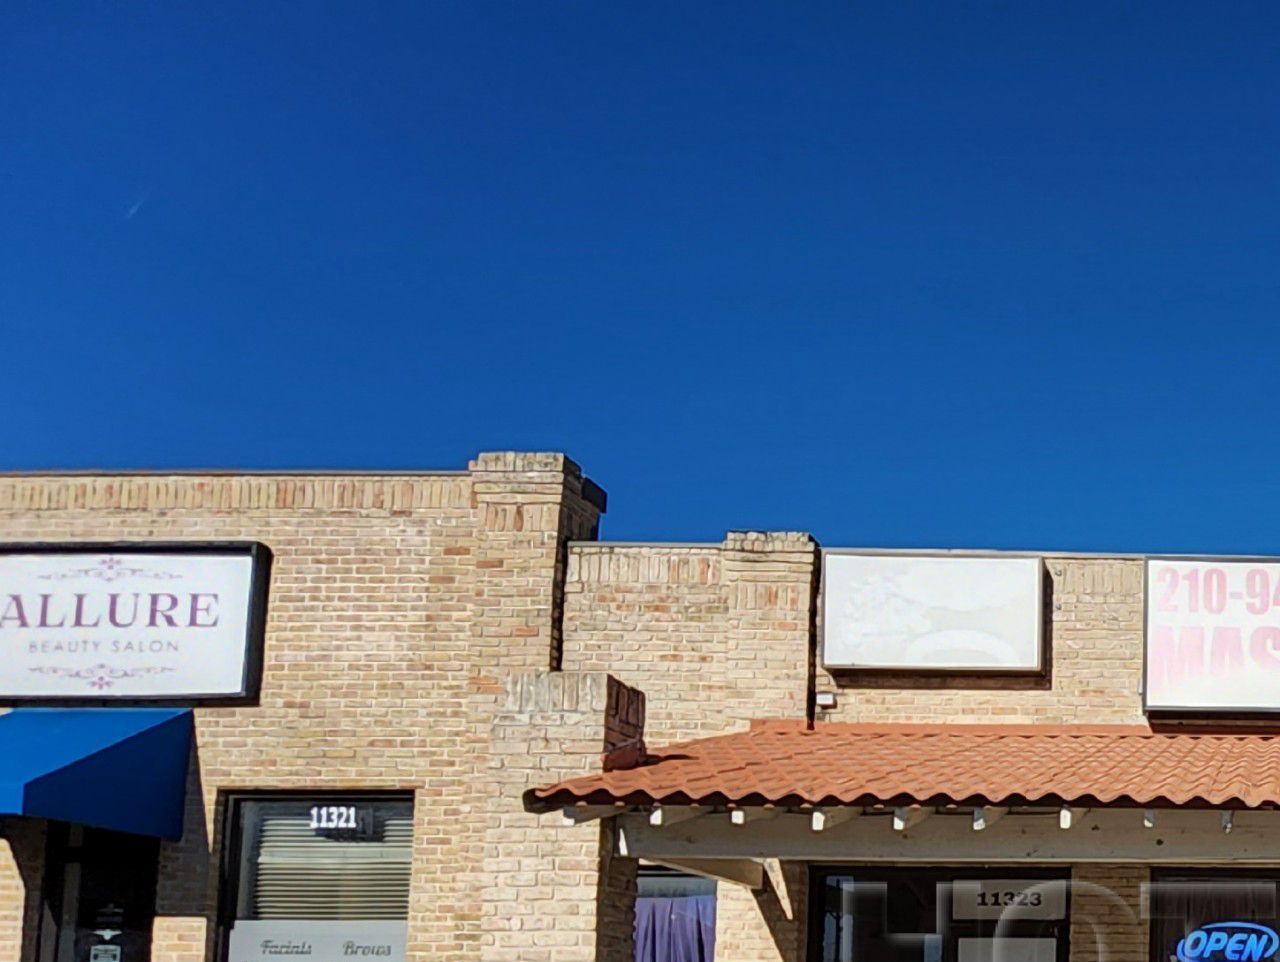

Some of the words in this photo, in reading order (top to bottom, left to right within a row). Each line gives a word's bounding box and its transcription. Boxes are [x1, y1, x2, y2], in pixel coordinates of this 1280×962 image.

[0, 593, 219, 628] ALLURE
[28, 639, 101, 653] BEAUTY
[112, 640, 180, 653] SALON
[309, 806, 357, 828] 11321
[977, 892, 1042, 907] 11323
[342, 941, 391, 957] Brows
[1184, 929, 1269, 962] OPEN
